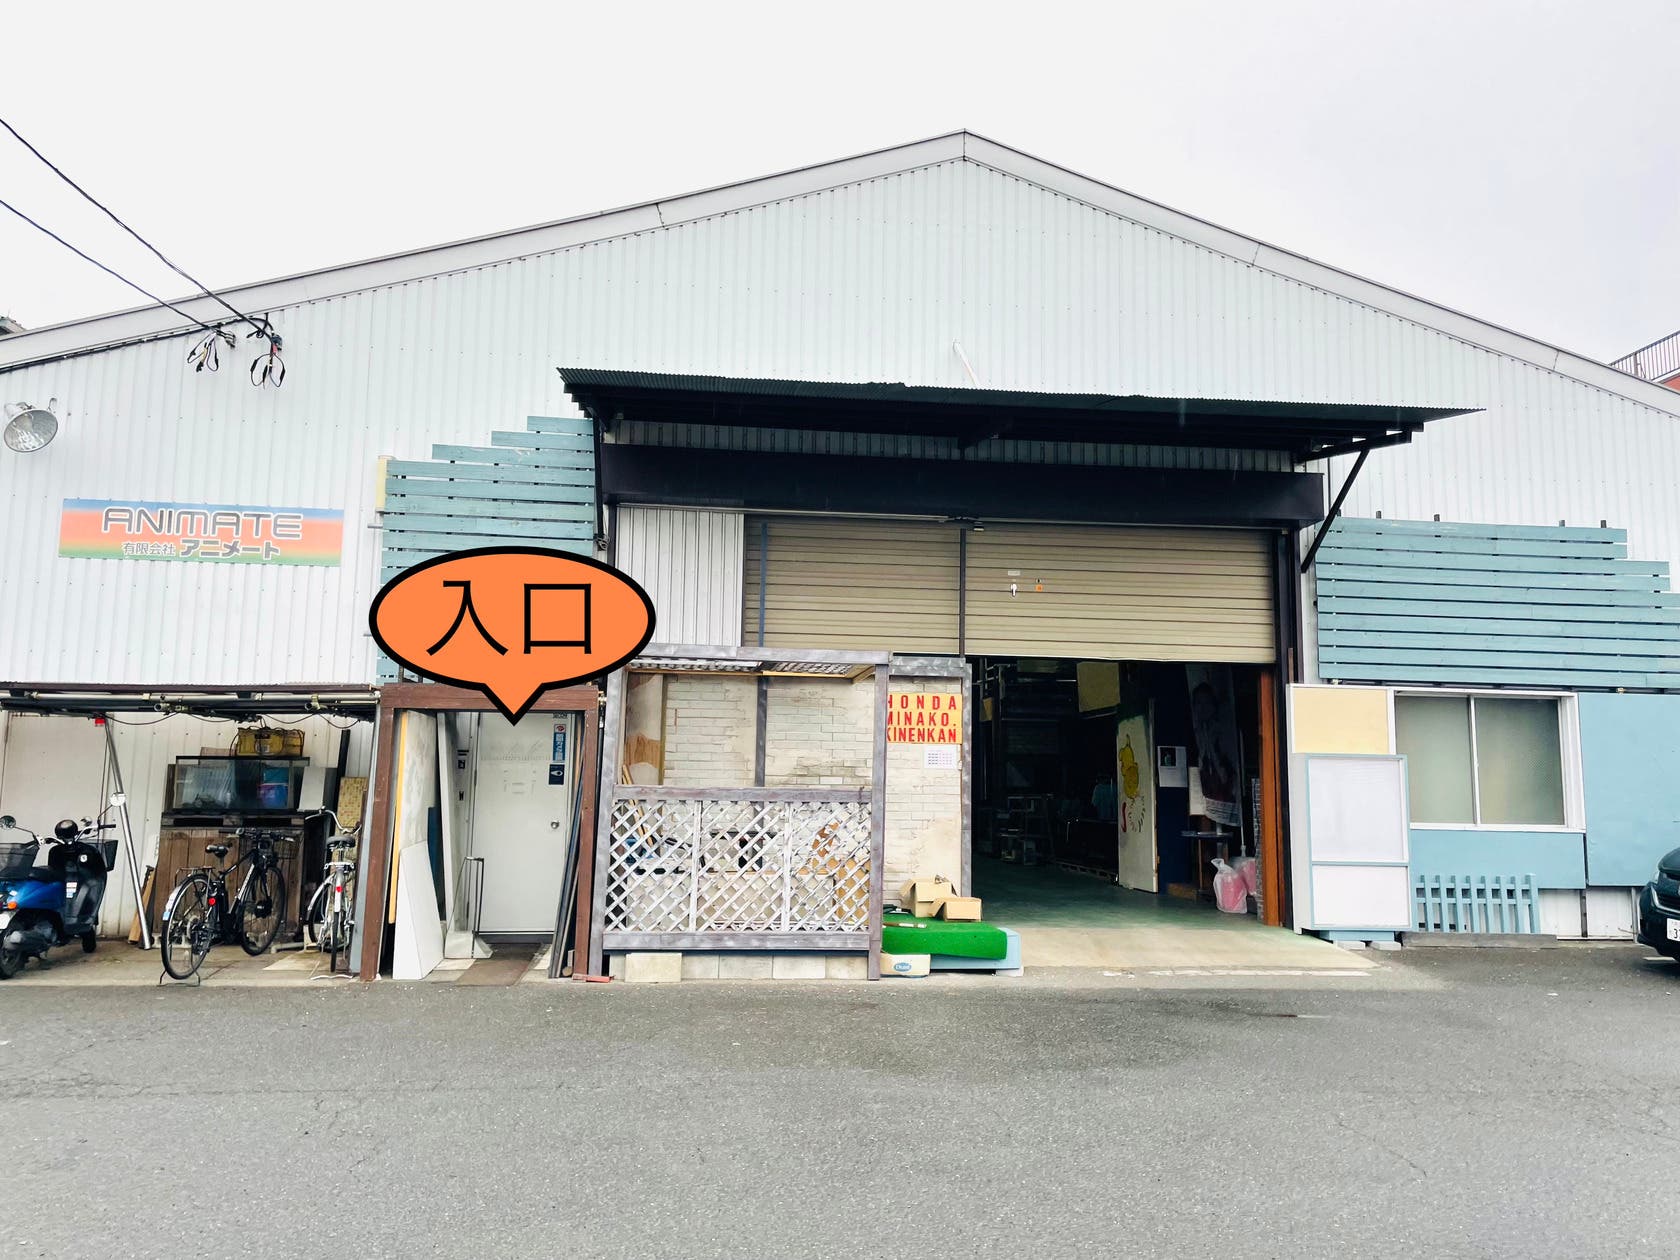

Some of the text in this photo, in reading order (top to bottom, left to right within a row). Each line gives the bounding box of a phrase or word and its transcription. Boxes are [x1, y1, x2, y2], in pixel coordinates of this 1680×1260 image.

[102, 507, 303, 538] ANIMATE
[123, 539, 281, 560] 有限会社 アニメート
